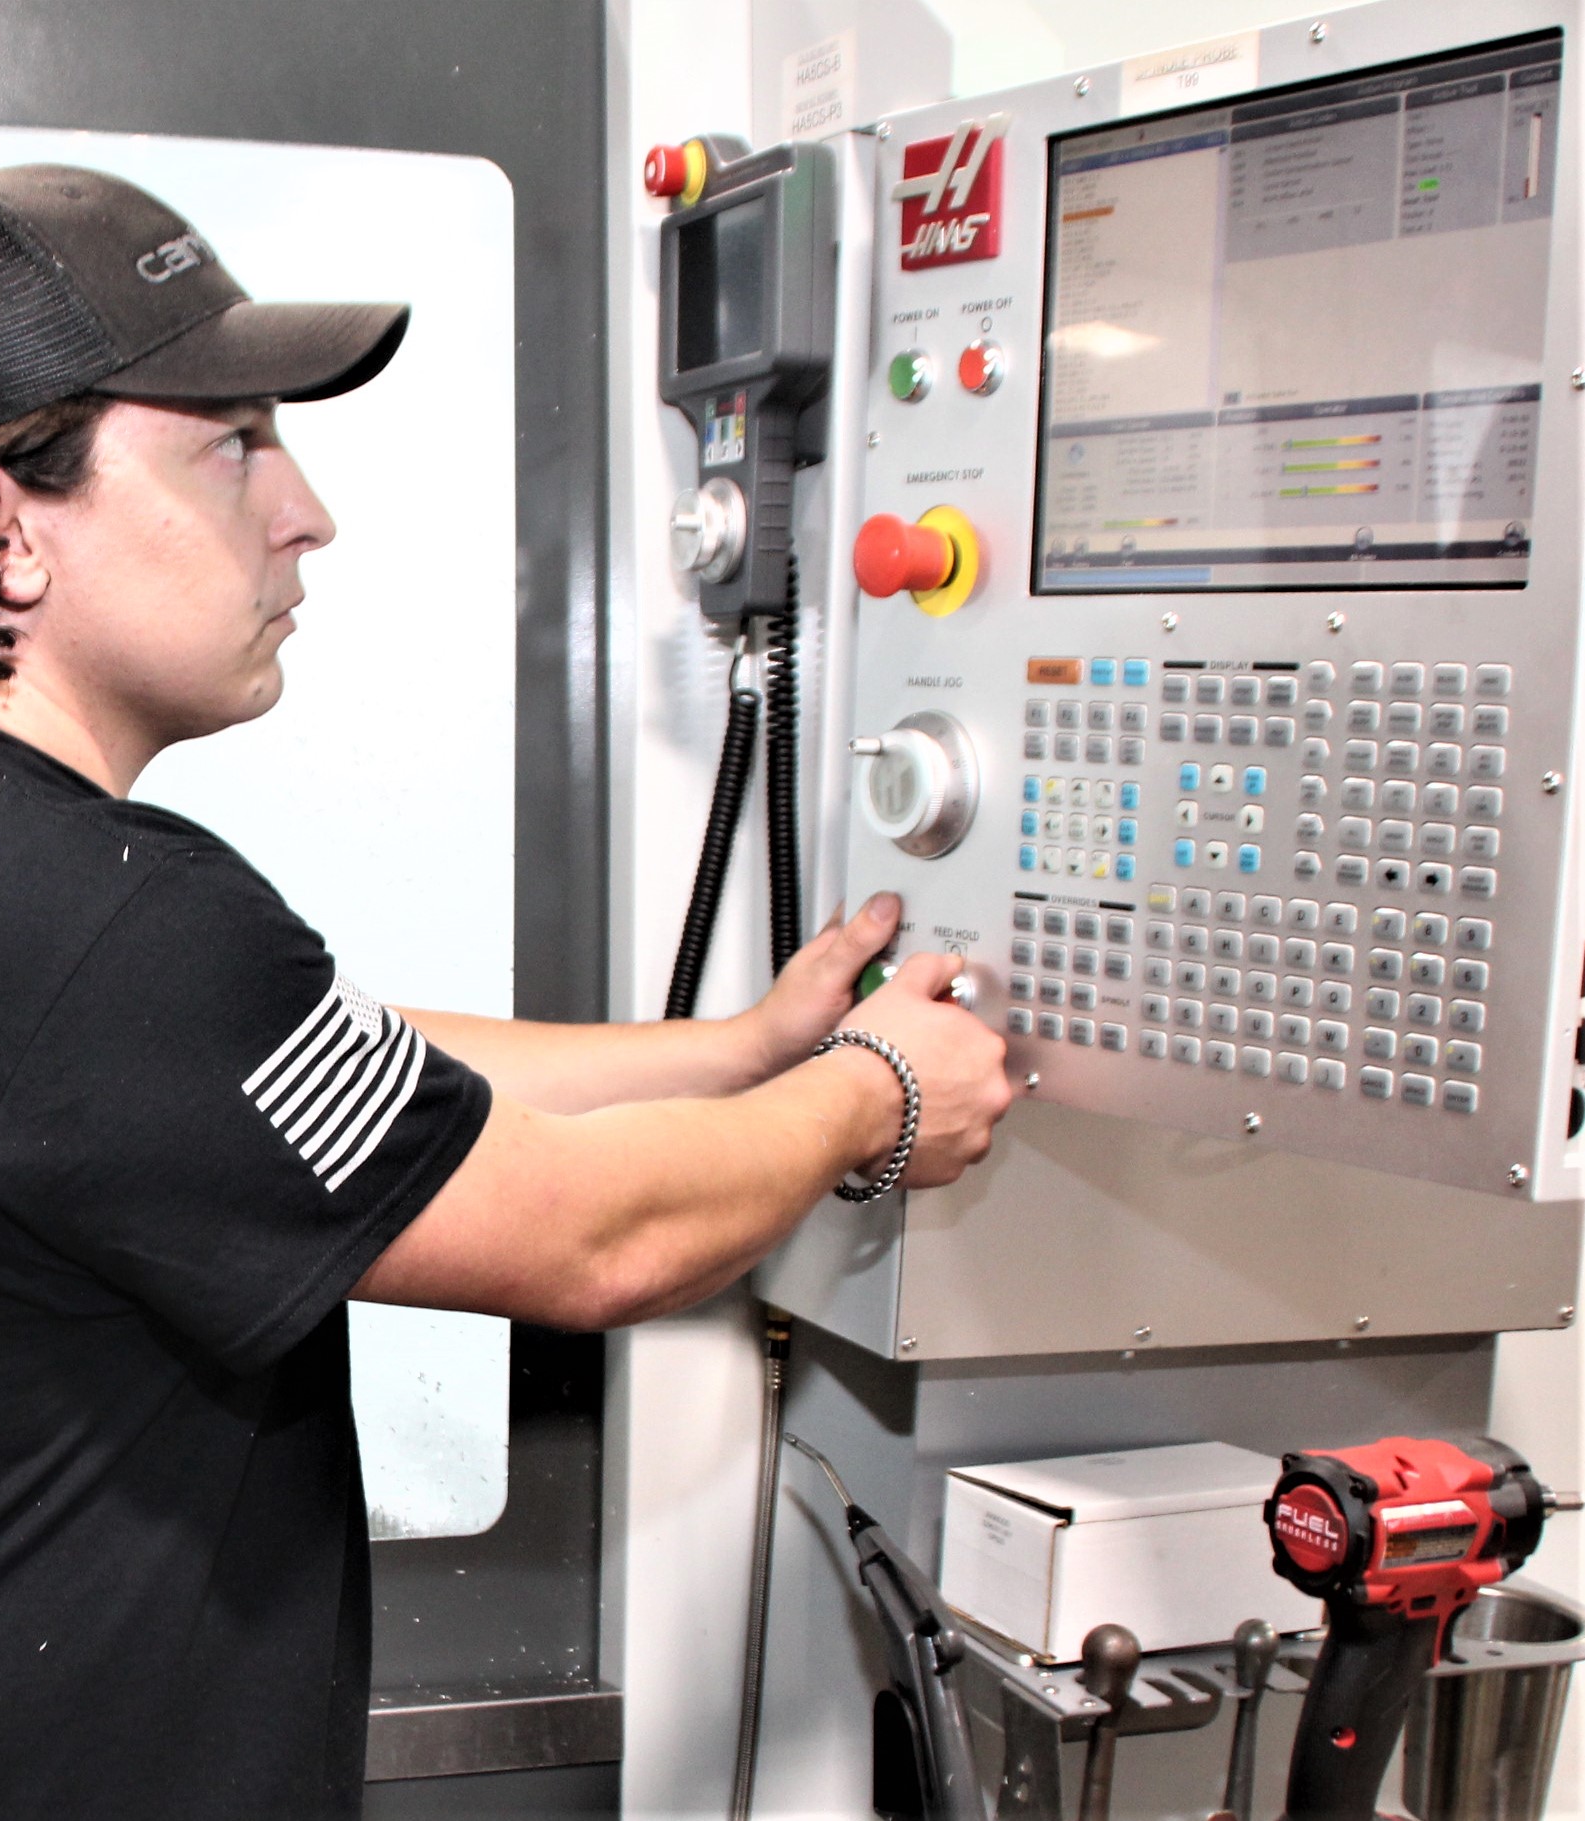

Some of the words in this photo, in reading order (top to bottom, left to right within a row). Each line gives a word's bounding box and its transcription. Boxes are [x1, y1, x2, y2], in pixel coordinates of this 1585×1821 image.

[900, 212, 991, 259] HAAS
[961, 299, 993, 314] POWER
[996, 296, 1014, 309] OFF
[892, 310, 923, 324] POWER
[925, 307, 940, 320] ON
[906, 470, 959, 484] EMERGENCY
[961, 467, 985, 481] STOP
[1209, 661, 1249, 670] DISPLAY
[907, 676, 941, 687] HANDLE
[943, 677, 964, 688] JOG
[1203, 811, 1236, 821] CURSOR
[1051, 895, 1097, 908] OVERRIDES
[1261, 906, 1269, 917] C
[934, 926, 953, 938] FEED
[956, 929, 980, 942] HOLD
[1222, 940, 1231, 951] H
[1278, 1503, 1339, 1540] FUEL
[1275, 1520, 1338, 1551] BRUSHLESS
